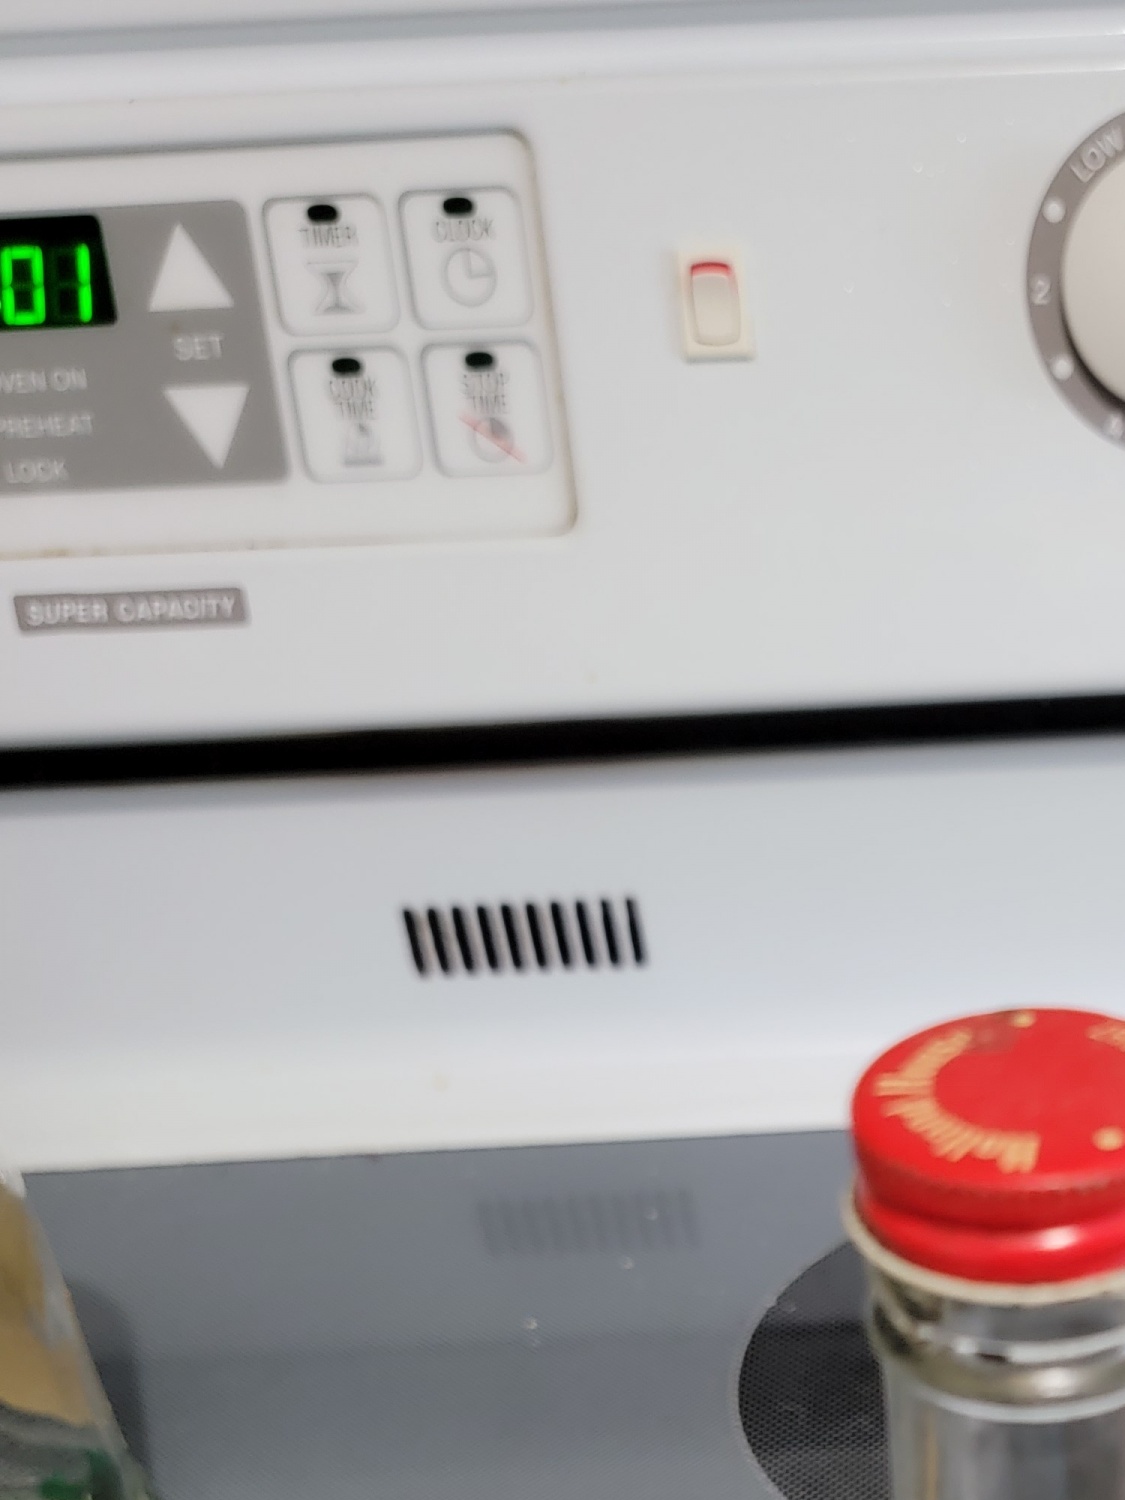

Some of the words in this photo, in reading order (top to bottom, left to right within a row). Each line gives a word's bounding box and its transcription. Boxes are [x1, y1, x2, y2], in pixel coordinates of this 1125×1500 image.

[1070, 126, 1125, 183] LOW
[433, 219, 495, 242] CLOCK
[1030, 276, 1050, 305] 2
[173, 335, 224, 361] SET
[0, 370, 47, 393] VEN
[53, 369, 88, 392] ON
[7, 459, 67, 483] LOCK
[27, 599, 108, 626] SUPER
[119, 595, 235, 622] CAPACITY
